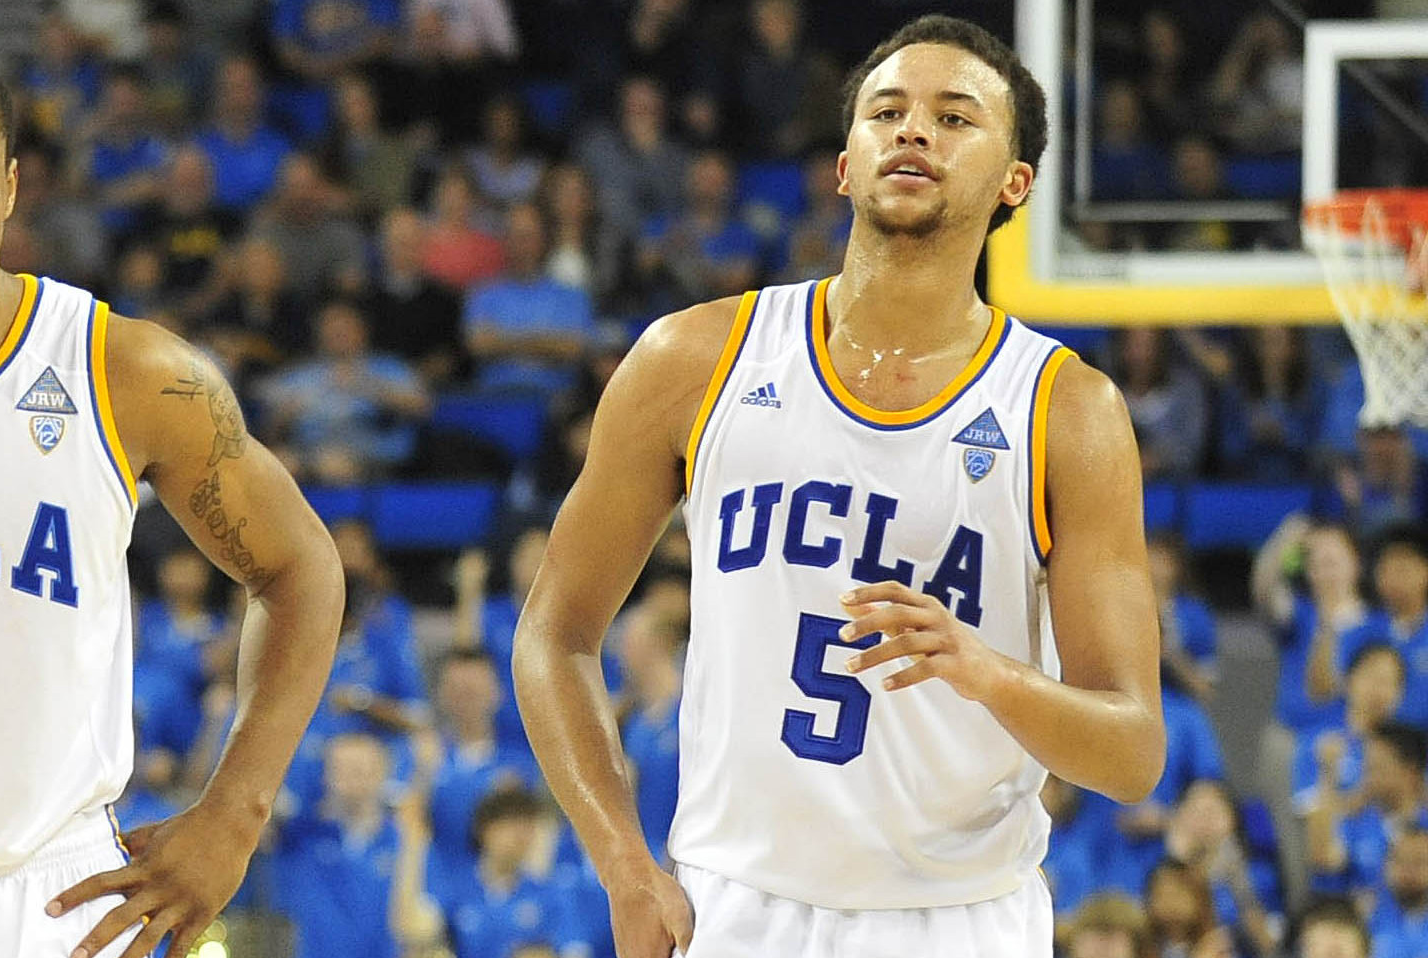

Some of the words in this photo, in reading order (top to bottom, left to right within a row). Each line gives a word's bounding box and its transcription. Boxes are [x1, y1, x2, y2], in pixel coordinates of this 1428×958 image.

[27, 391, 67, 408] JRW
[963, 428, 1002, 443] JRW
[717, 480, 984, 628] UCLA
[780, 612, 883, 766] 5
